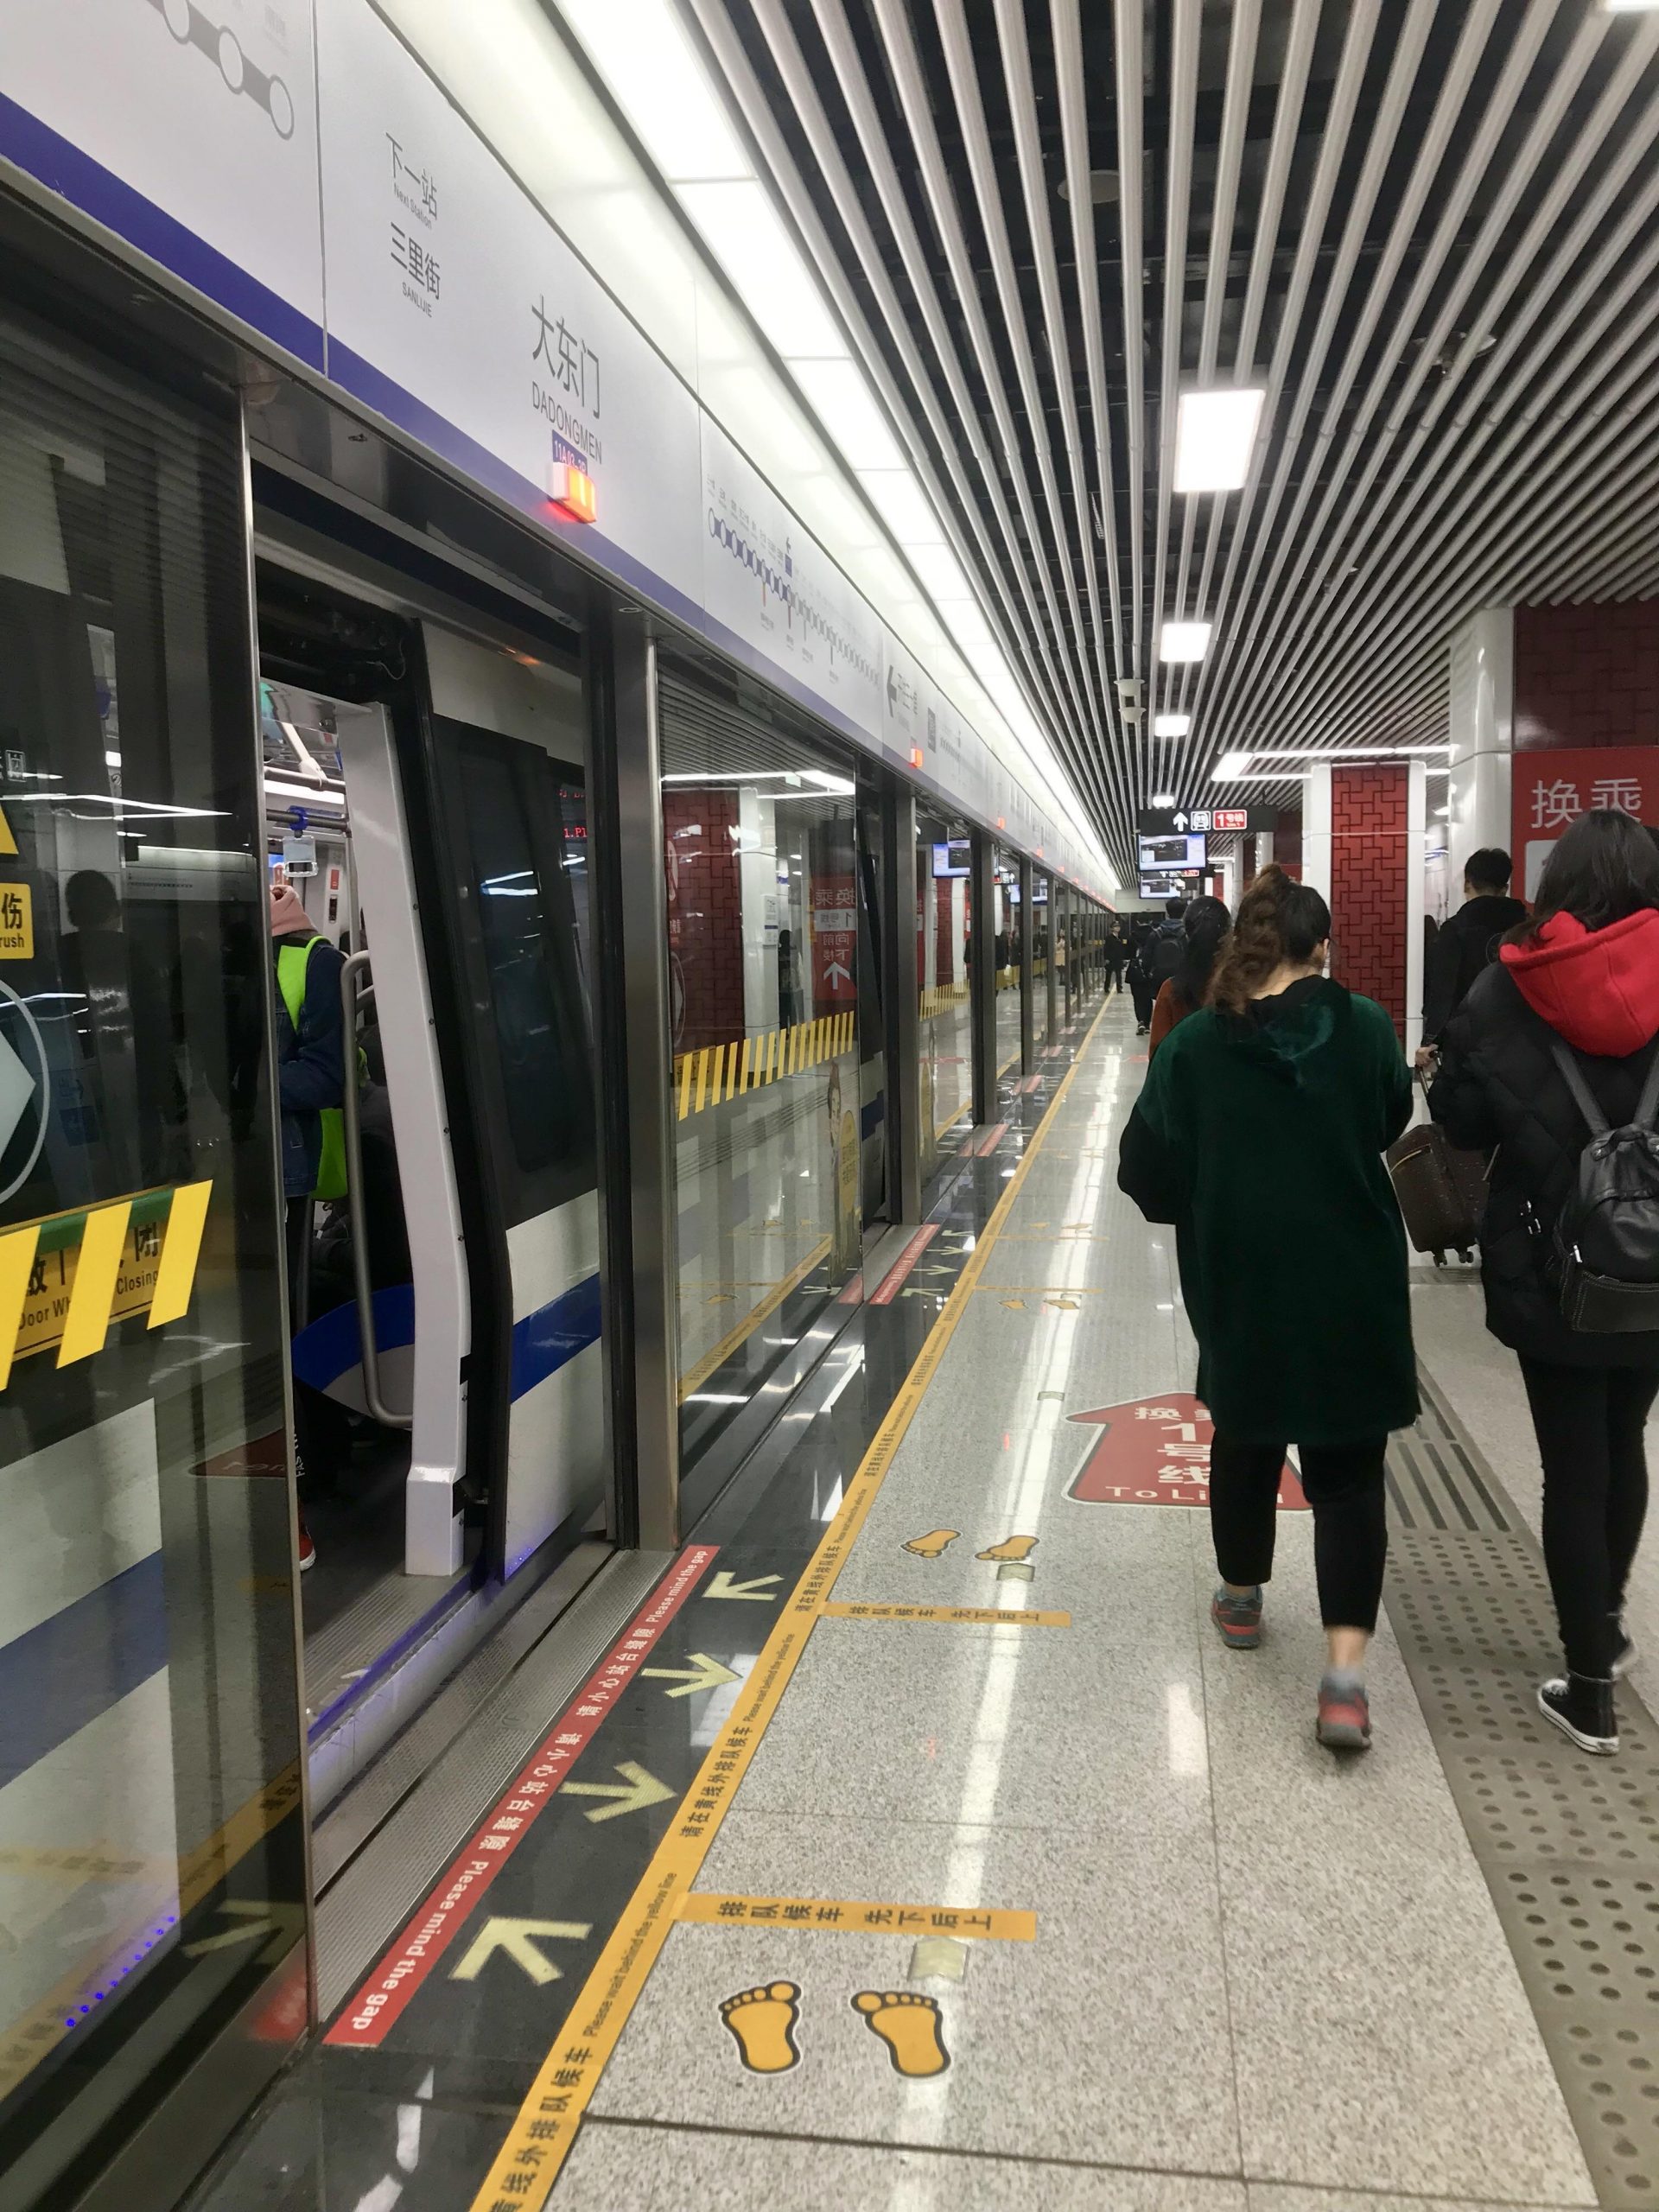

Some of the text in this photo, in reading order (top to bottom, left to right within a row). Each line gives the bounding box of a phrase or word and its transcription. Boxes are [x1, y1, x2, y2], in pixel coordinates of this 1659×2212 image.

[385, 131, 437, 220] 下一站
[393, 182, 432, 229] Next Station
[391, 221, 441, 300] 三里街
[402, 282, 432, 317] SANLIJIE
[531, 294, 601, 419] 大东门
[531, 381, 602, 464] DADONGMEN
[1531, 779, 1643, 829] 换乘
[575, 1550, 710, 1717] 请小心站台缝隙 Please mind the gap
[352, 1732, 583, 2031] 请小心站台缝隙 Please mind the gap
[717, 1900, 992, 1931] 排队候车 先下后上
[582, 1999, 614, 2038] Please
[606, 1974, 627, 1999] wait
[620, 1938, 645, 1974] behind
[633, 1920, 654, 1937] the
